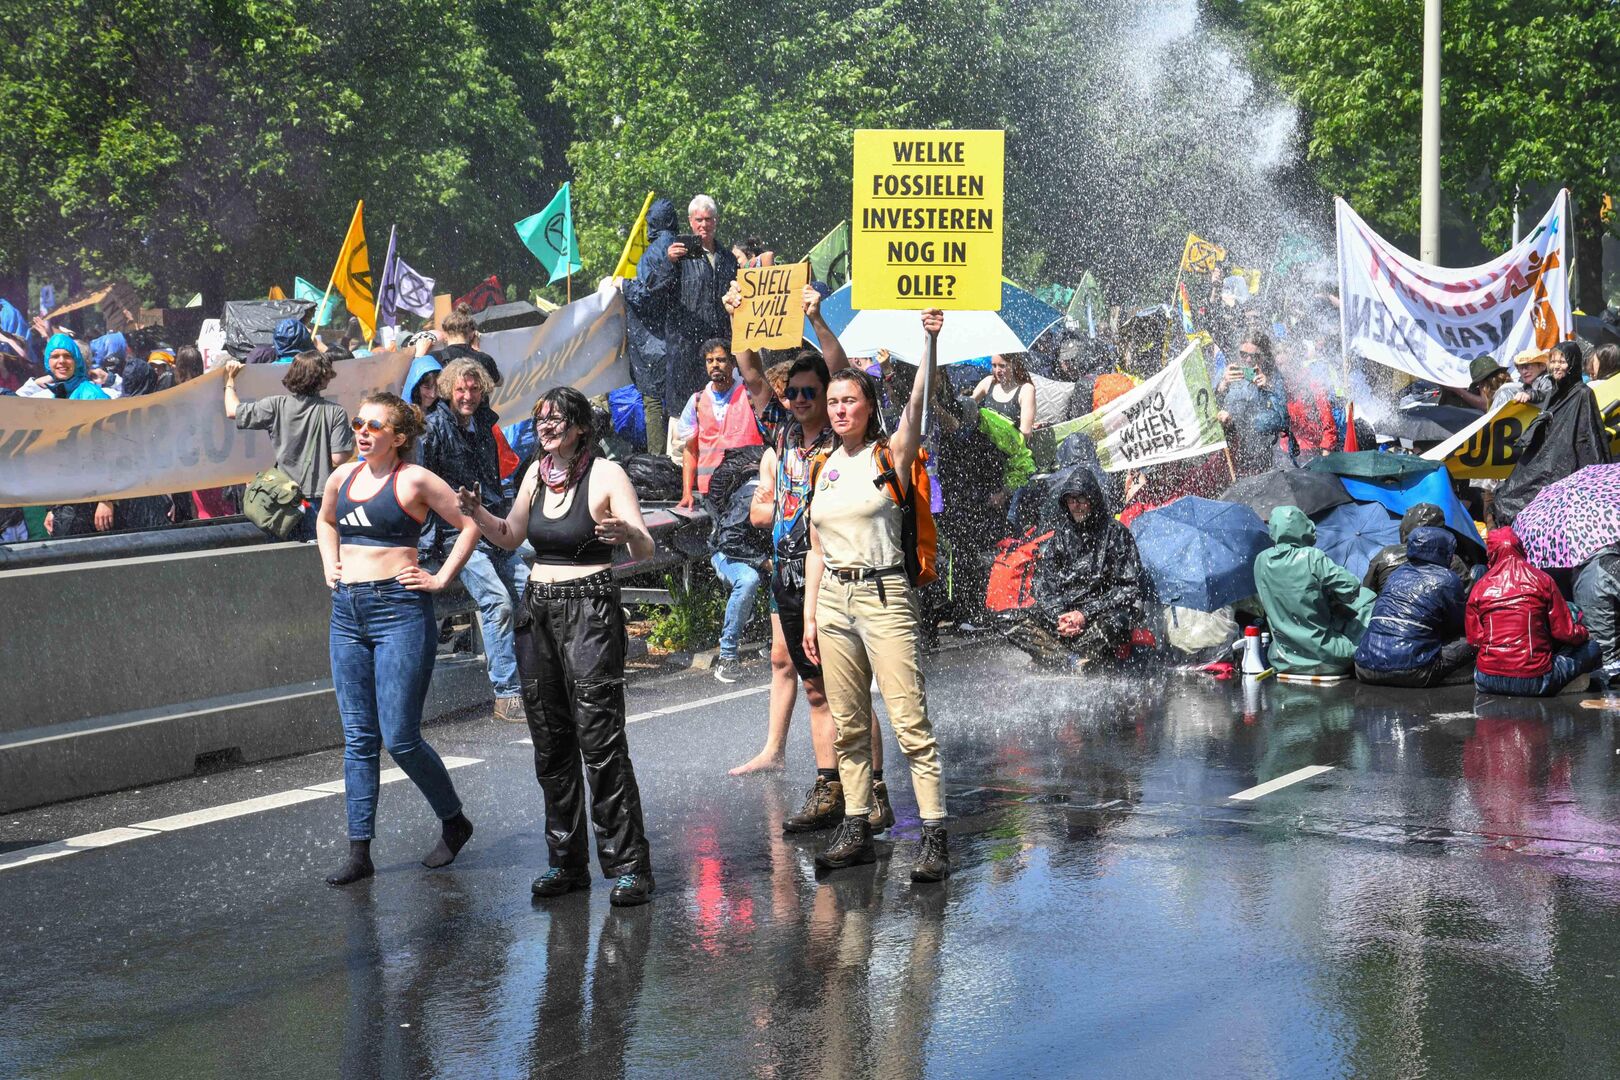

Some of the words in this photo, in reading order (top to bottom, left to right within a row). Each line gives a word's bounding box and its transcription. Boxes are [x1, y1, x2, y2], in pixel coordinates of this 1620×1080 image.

[893, 141, 965, 163] WELKE
[873, 174, 984, 196] FOSSIELEN
[862, 207, 993, 230] INVESTEREN
[887, 241, 935, 263] NOG
[943, 241, 967, 263] IN
[743, 269, 792, 299] SHELL
[897, 274, 957, 296] OLIE?
[745, 317, 784, 340] FALL
[1121, 391, 1165, 425] WHO
[1119, 409, 1178, 445] WHEN
[1119, 428, 1186, 463] WHERE
